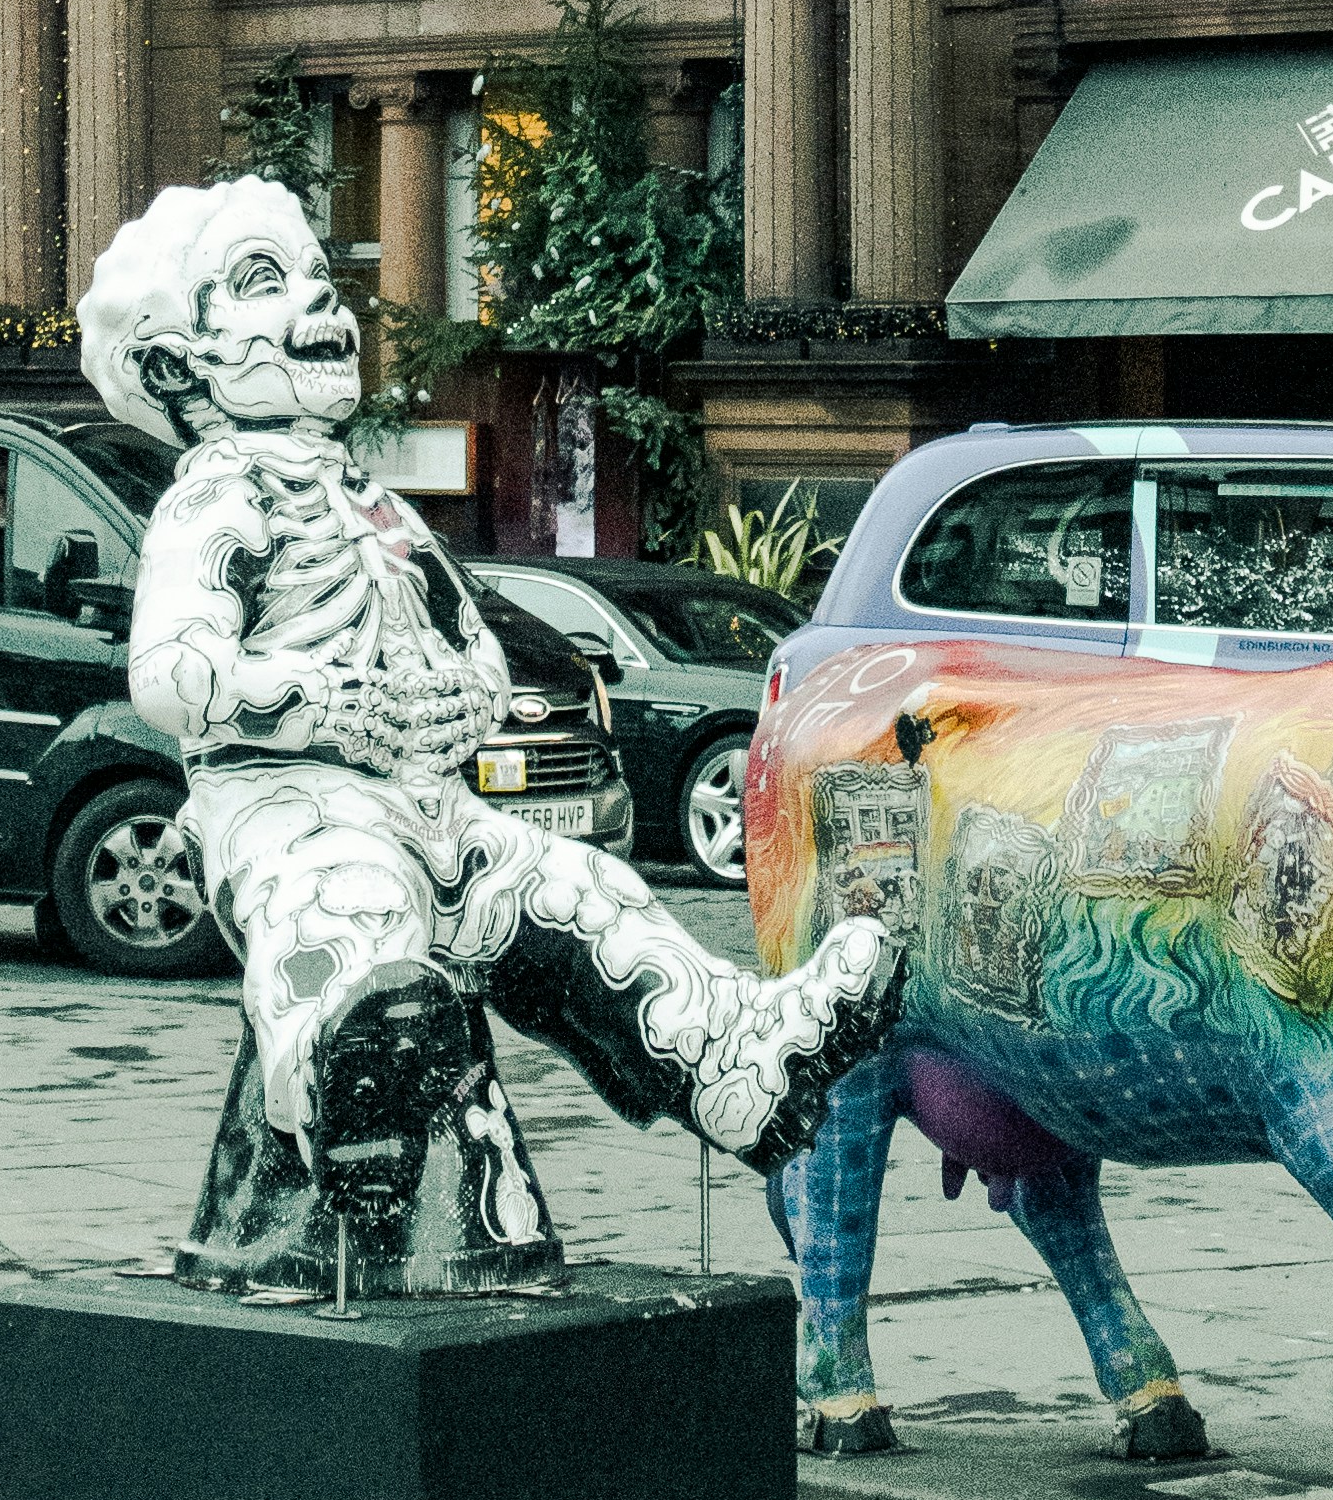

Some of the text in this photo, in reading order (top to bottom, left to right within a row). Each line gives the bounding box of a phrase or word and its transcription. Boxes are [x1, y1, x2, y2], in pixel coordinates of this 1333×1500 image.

[272, 350, 326, 393] GRANNY
[1238, 640, 1309, 653] EDINBURGH
[557, 805, 586, 831] HVP
